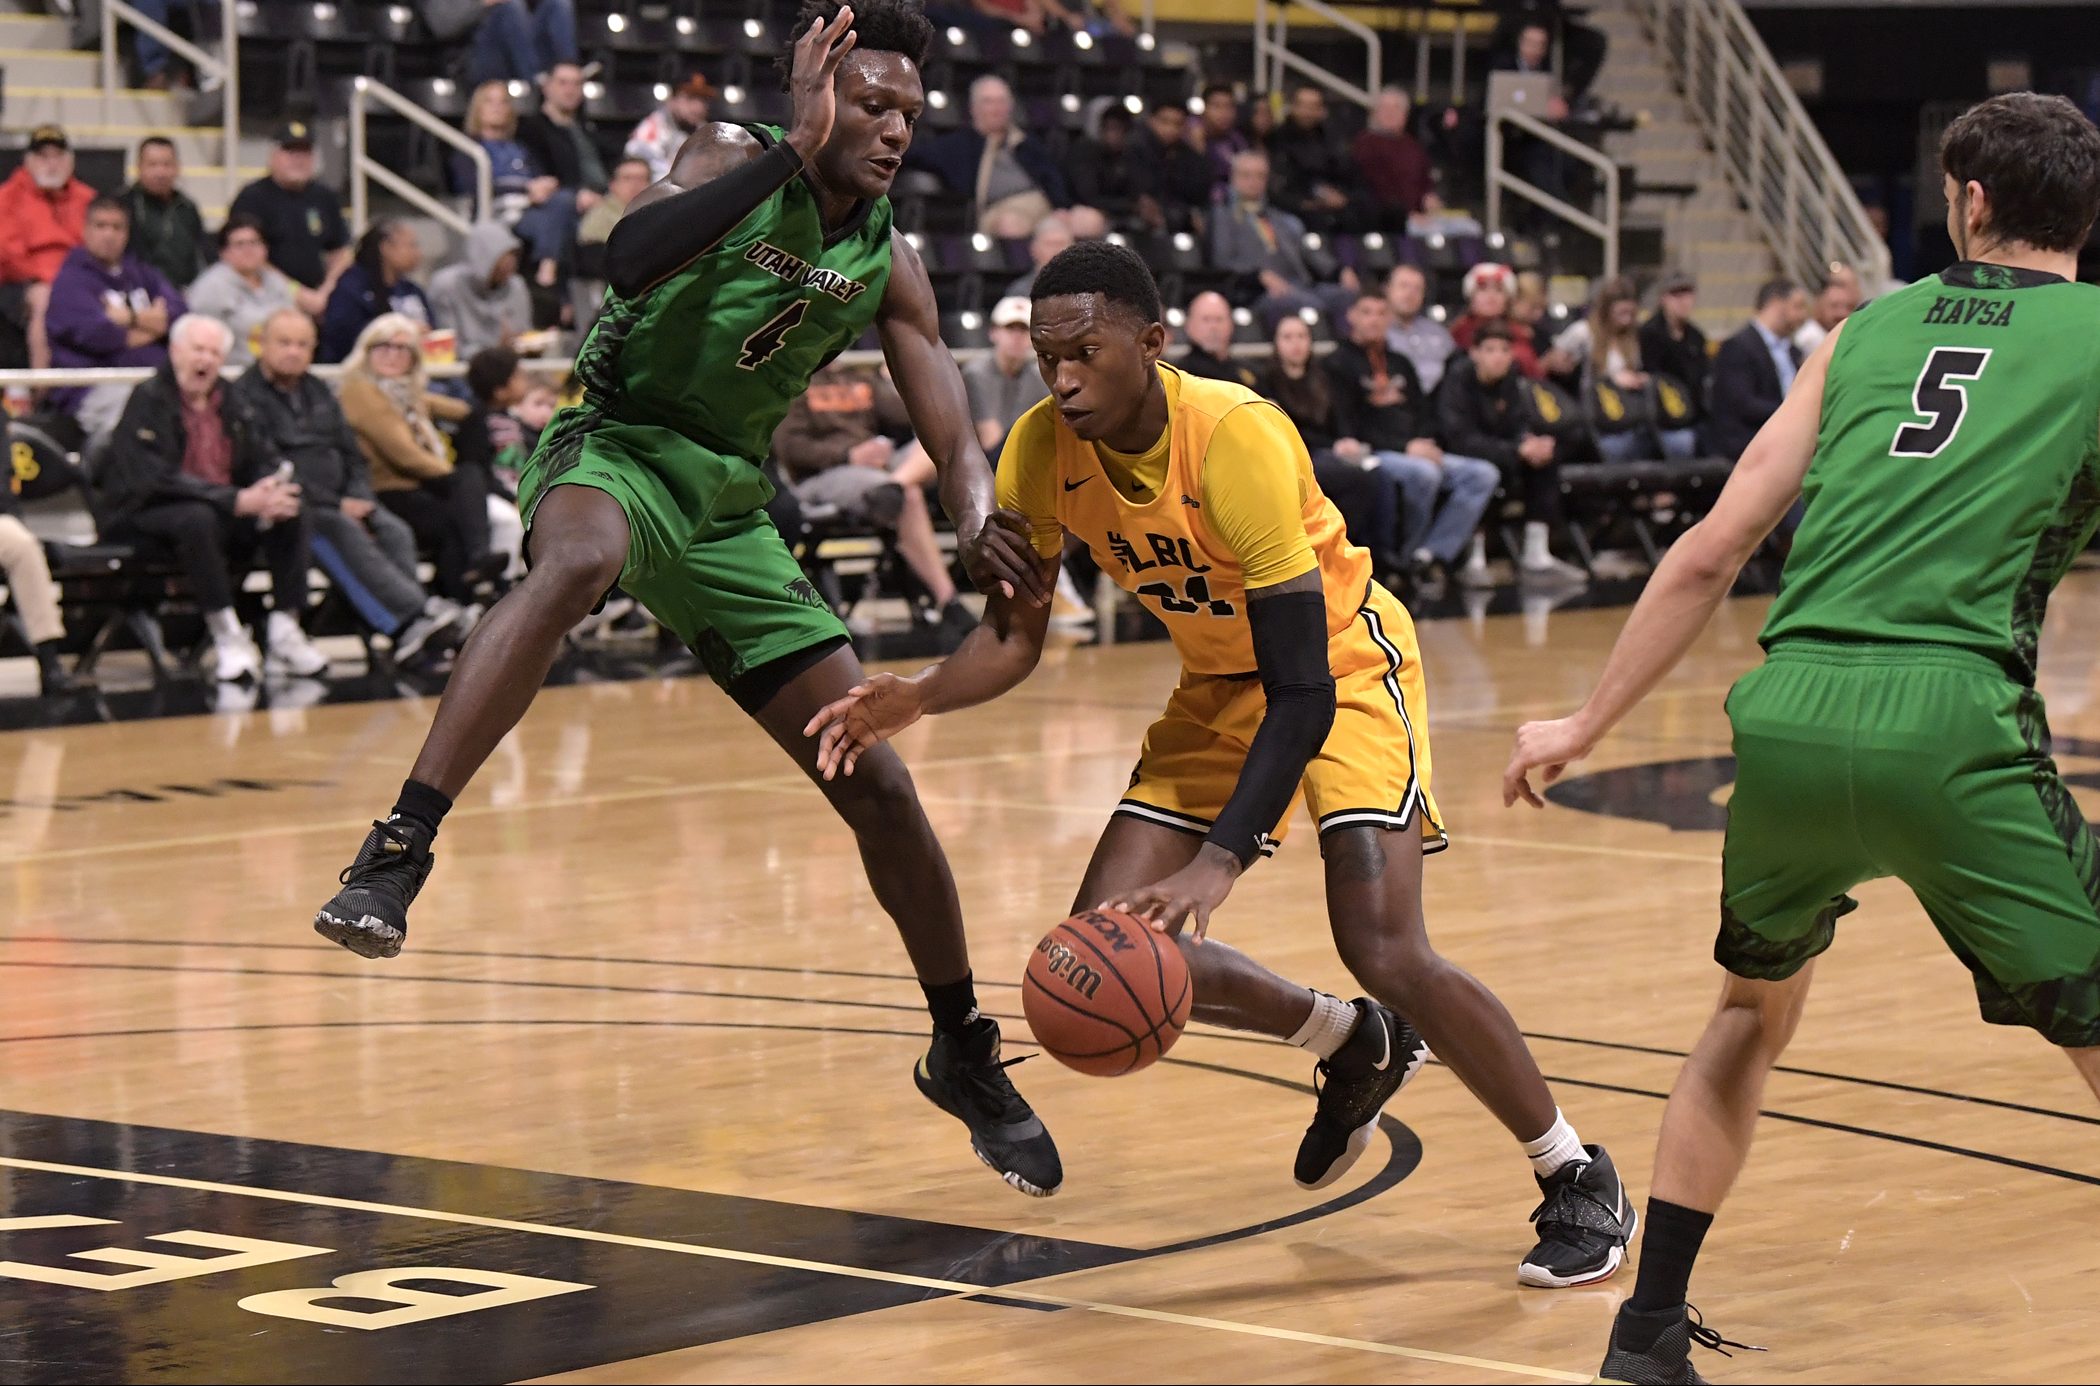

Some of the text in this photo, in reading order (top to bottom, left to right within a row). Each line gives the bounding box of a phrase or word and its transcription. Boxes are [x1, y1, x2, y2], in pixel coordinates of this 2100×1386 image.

[744, 240, 805, 282] UTAH
[736, 298, 811, 371] 4
[1888, 346, 1994, 459] 5
[1125, 532, 1213, 574] LBC
[0, 1214, 598, 1330] BE
